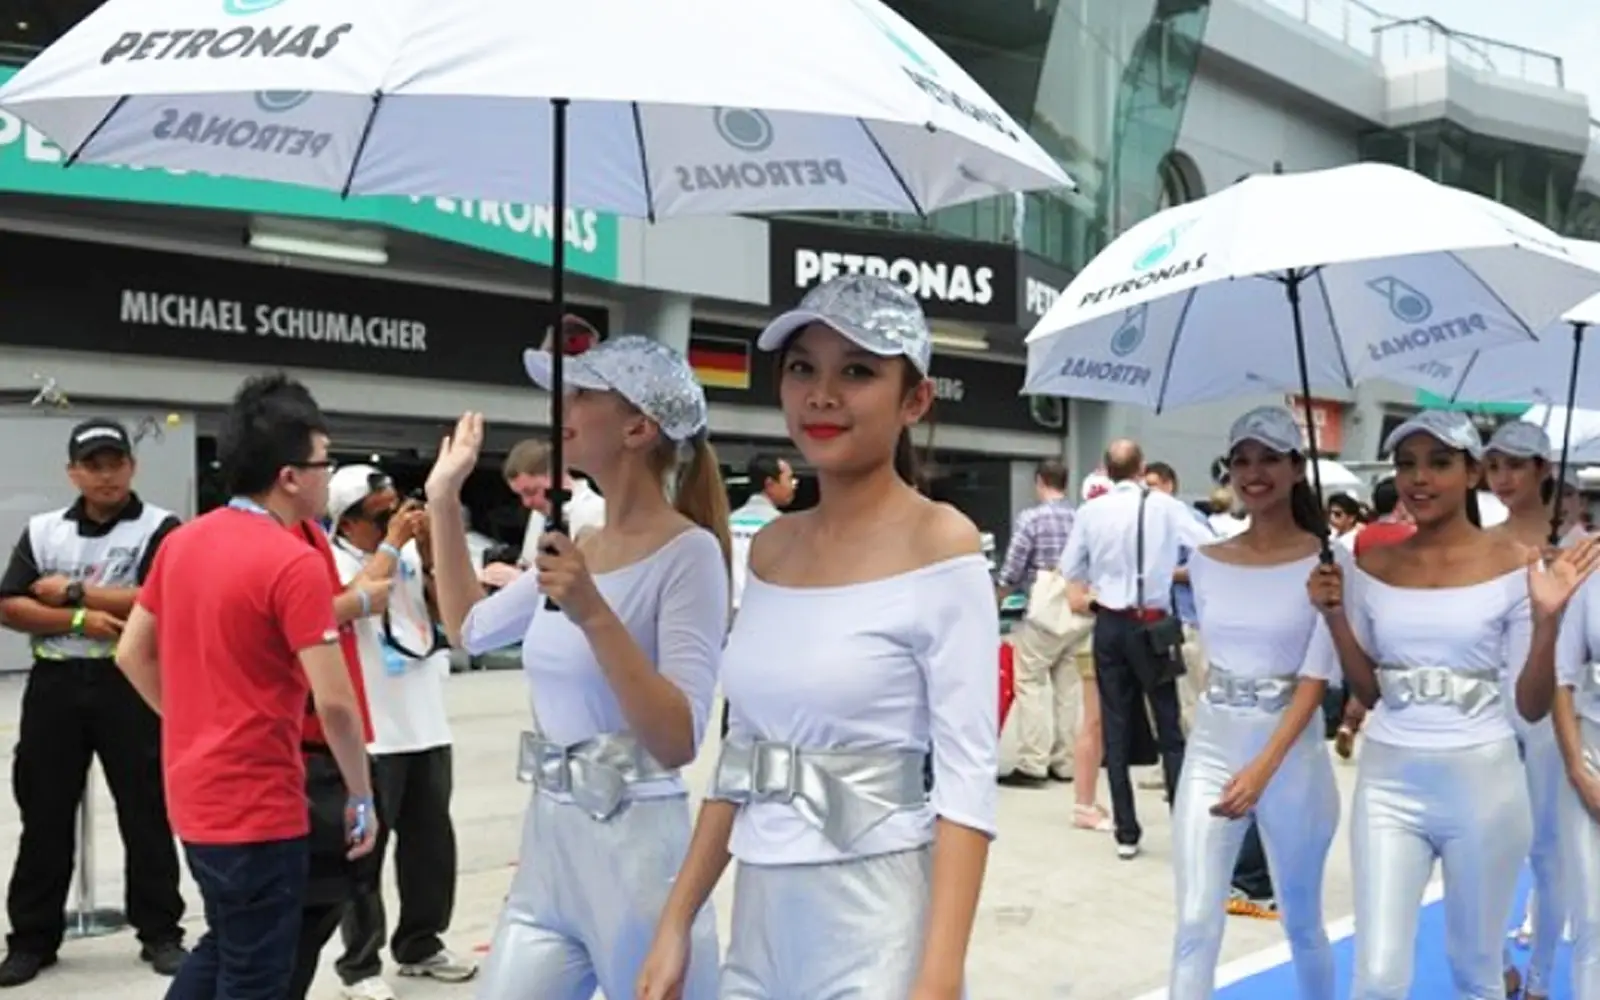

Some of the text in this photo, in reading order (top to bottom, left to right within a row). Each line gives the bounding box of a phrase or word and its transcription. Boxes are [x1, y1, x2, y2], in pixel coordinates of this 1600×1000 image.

[101, 22, 353, 66] PETRONAS
[410, 195, 598, 253] RONAS
[1078, 252, 1208, 309] PETRONAS
[120, 289, 427, 351] MICHAEL SCHUMACHER
